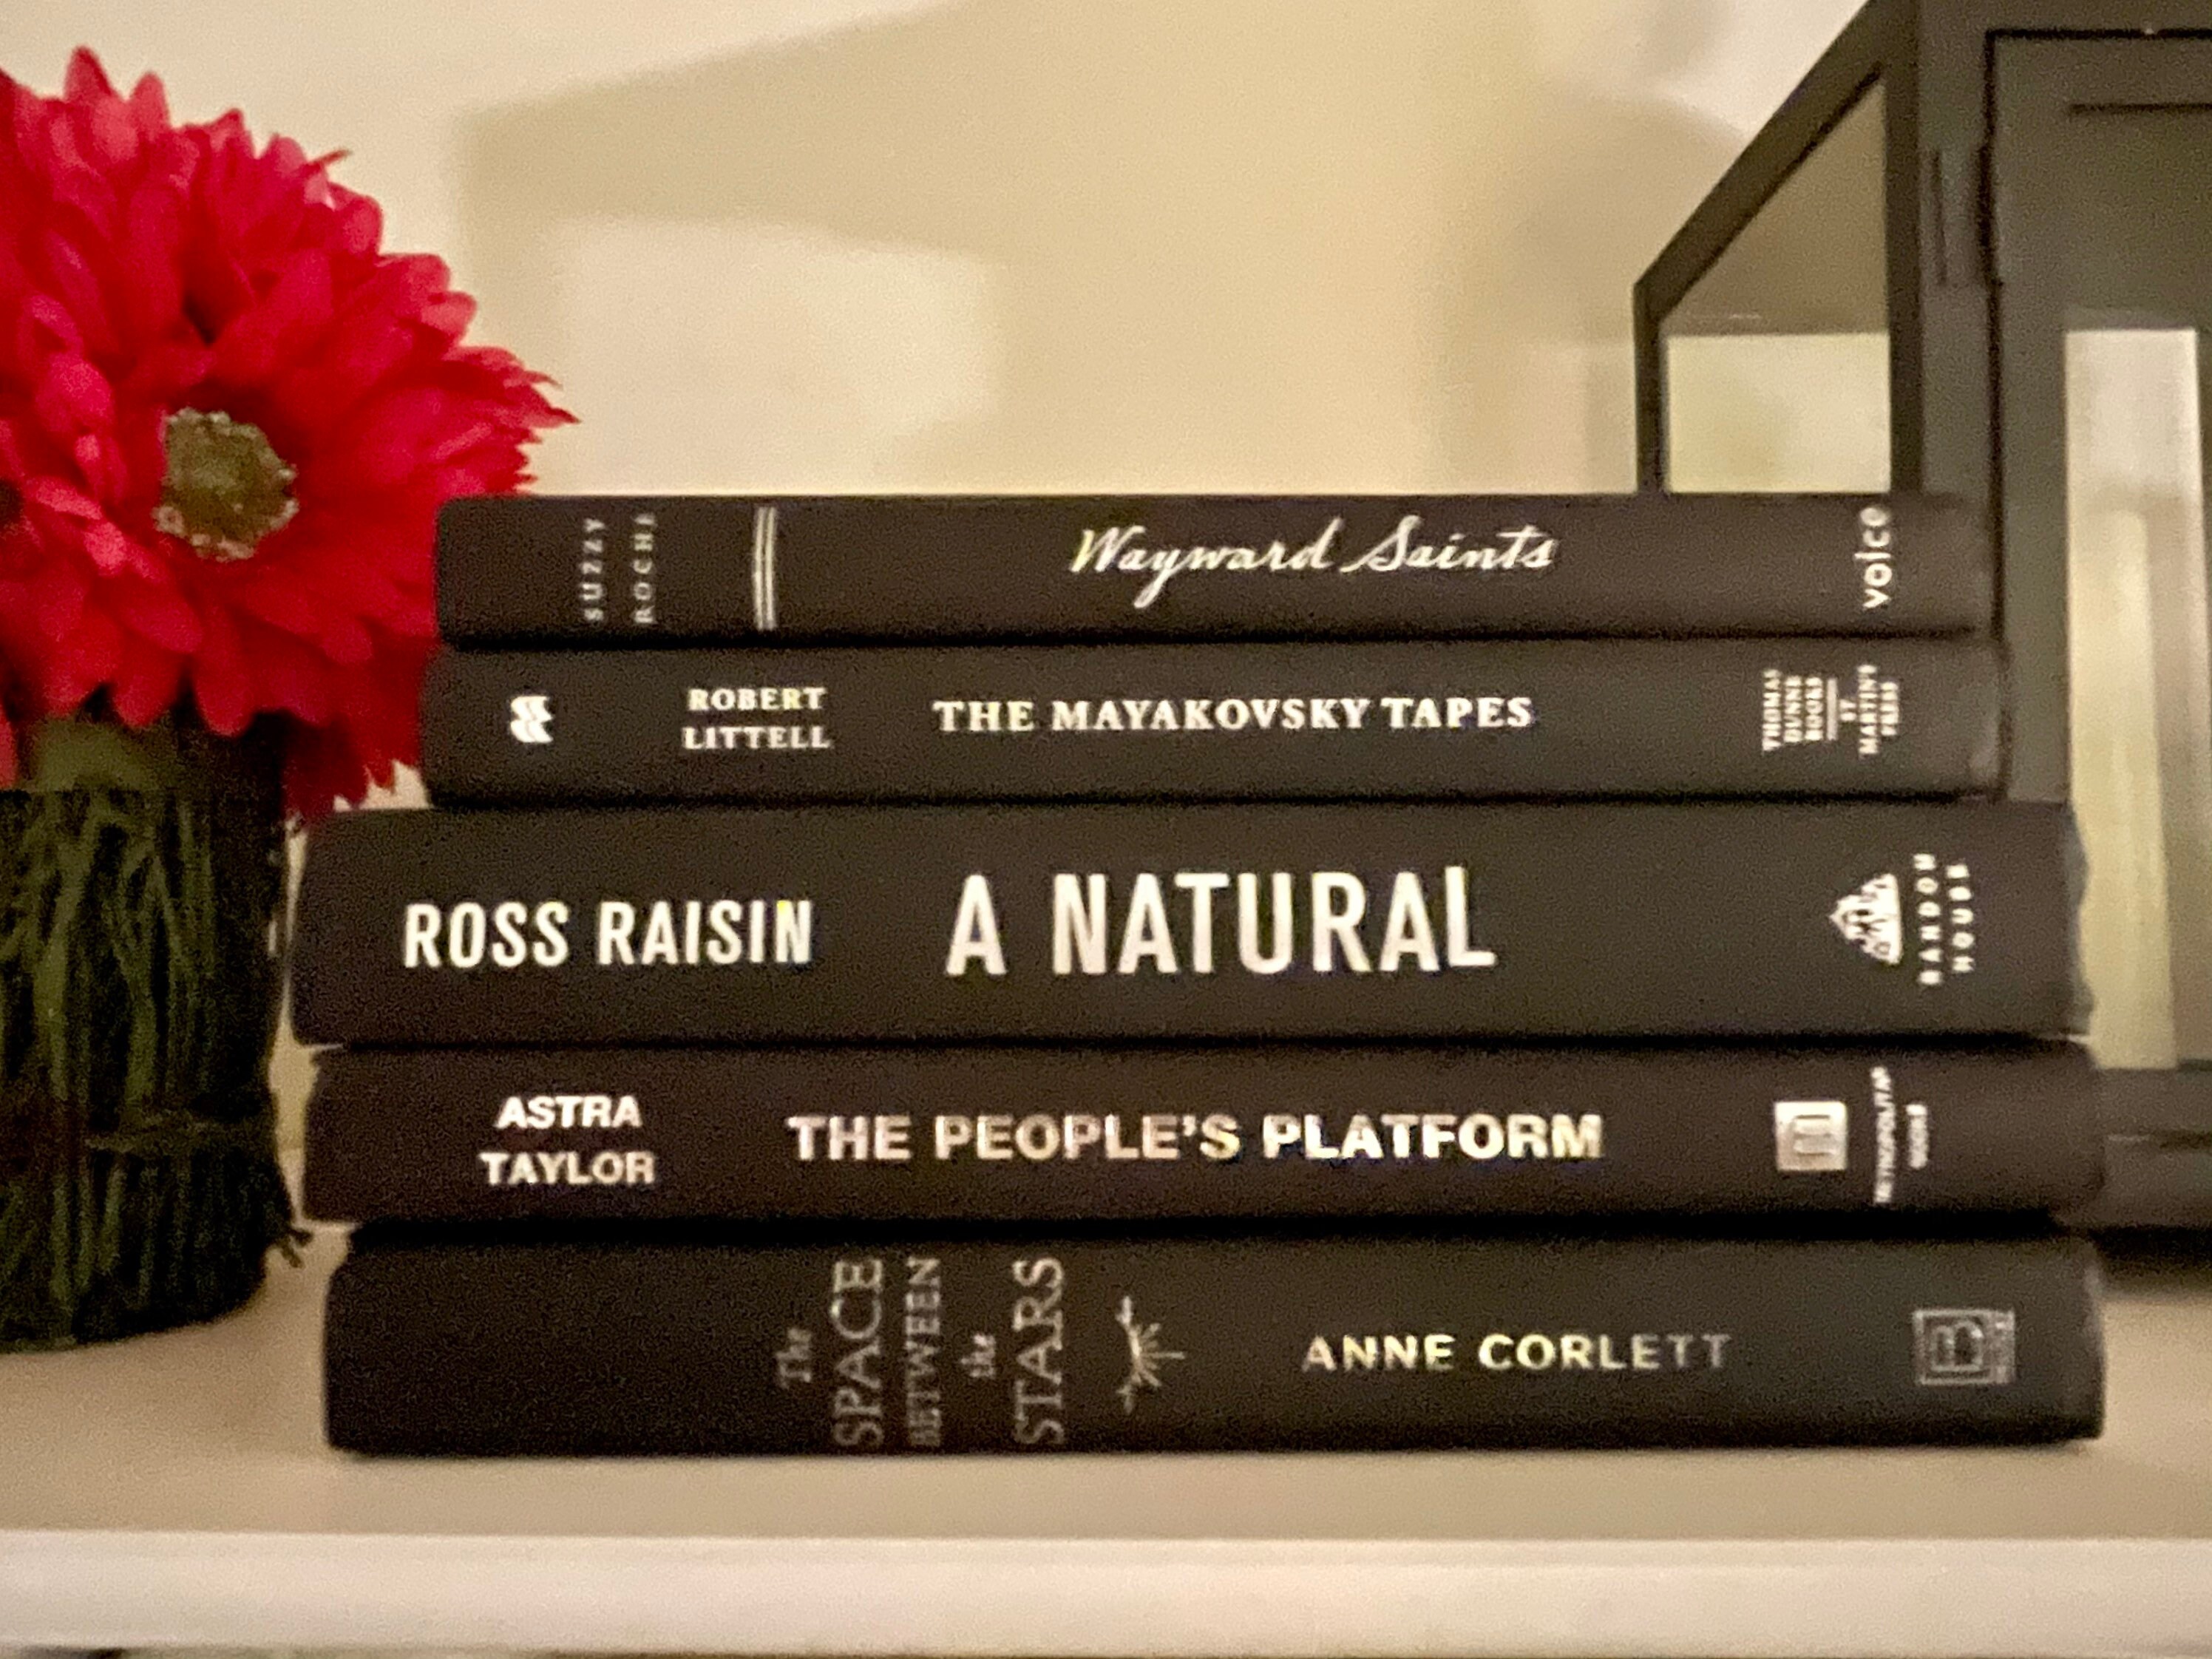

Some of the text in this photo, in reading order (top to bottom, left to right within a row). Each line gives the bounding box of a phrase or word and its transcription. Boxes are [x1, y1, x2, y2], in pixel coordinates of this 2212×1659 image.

[580, 518, 606, 622] SUZZY
[1070, 515, 1558, 609] Wayward Saints
[688, 686, 827, 712] ROBERT
[932, 696, 1533, 733] THE MAYAKOVSKY TAPES
[682, 725, 831, 750] LITTELL
[404, 899, 812, 968] ROSS RAISIN
[946, 866, 1496, 976] A NATURAL
[495, 1094, 642, 1130] ASTRA
[786, 1113, 1603, 1161] THE PEOPLE'S PLATFORM
[478, 1150, 656, 1186] TAYLOR
[775, 1326, 812, 1389] The
[829, 1258, 884, 1446] SPACE
[904, 1255, 942, 1447] BETWEEN
[1011, 1257, 1065, 1445] STARS
[1302, 1333, 1731, 1371] ANNE CORLETT
